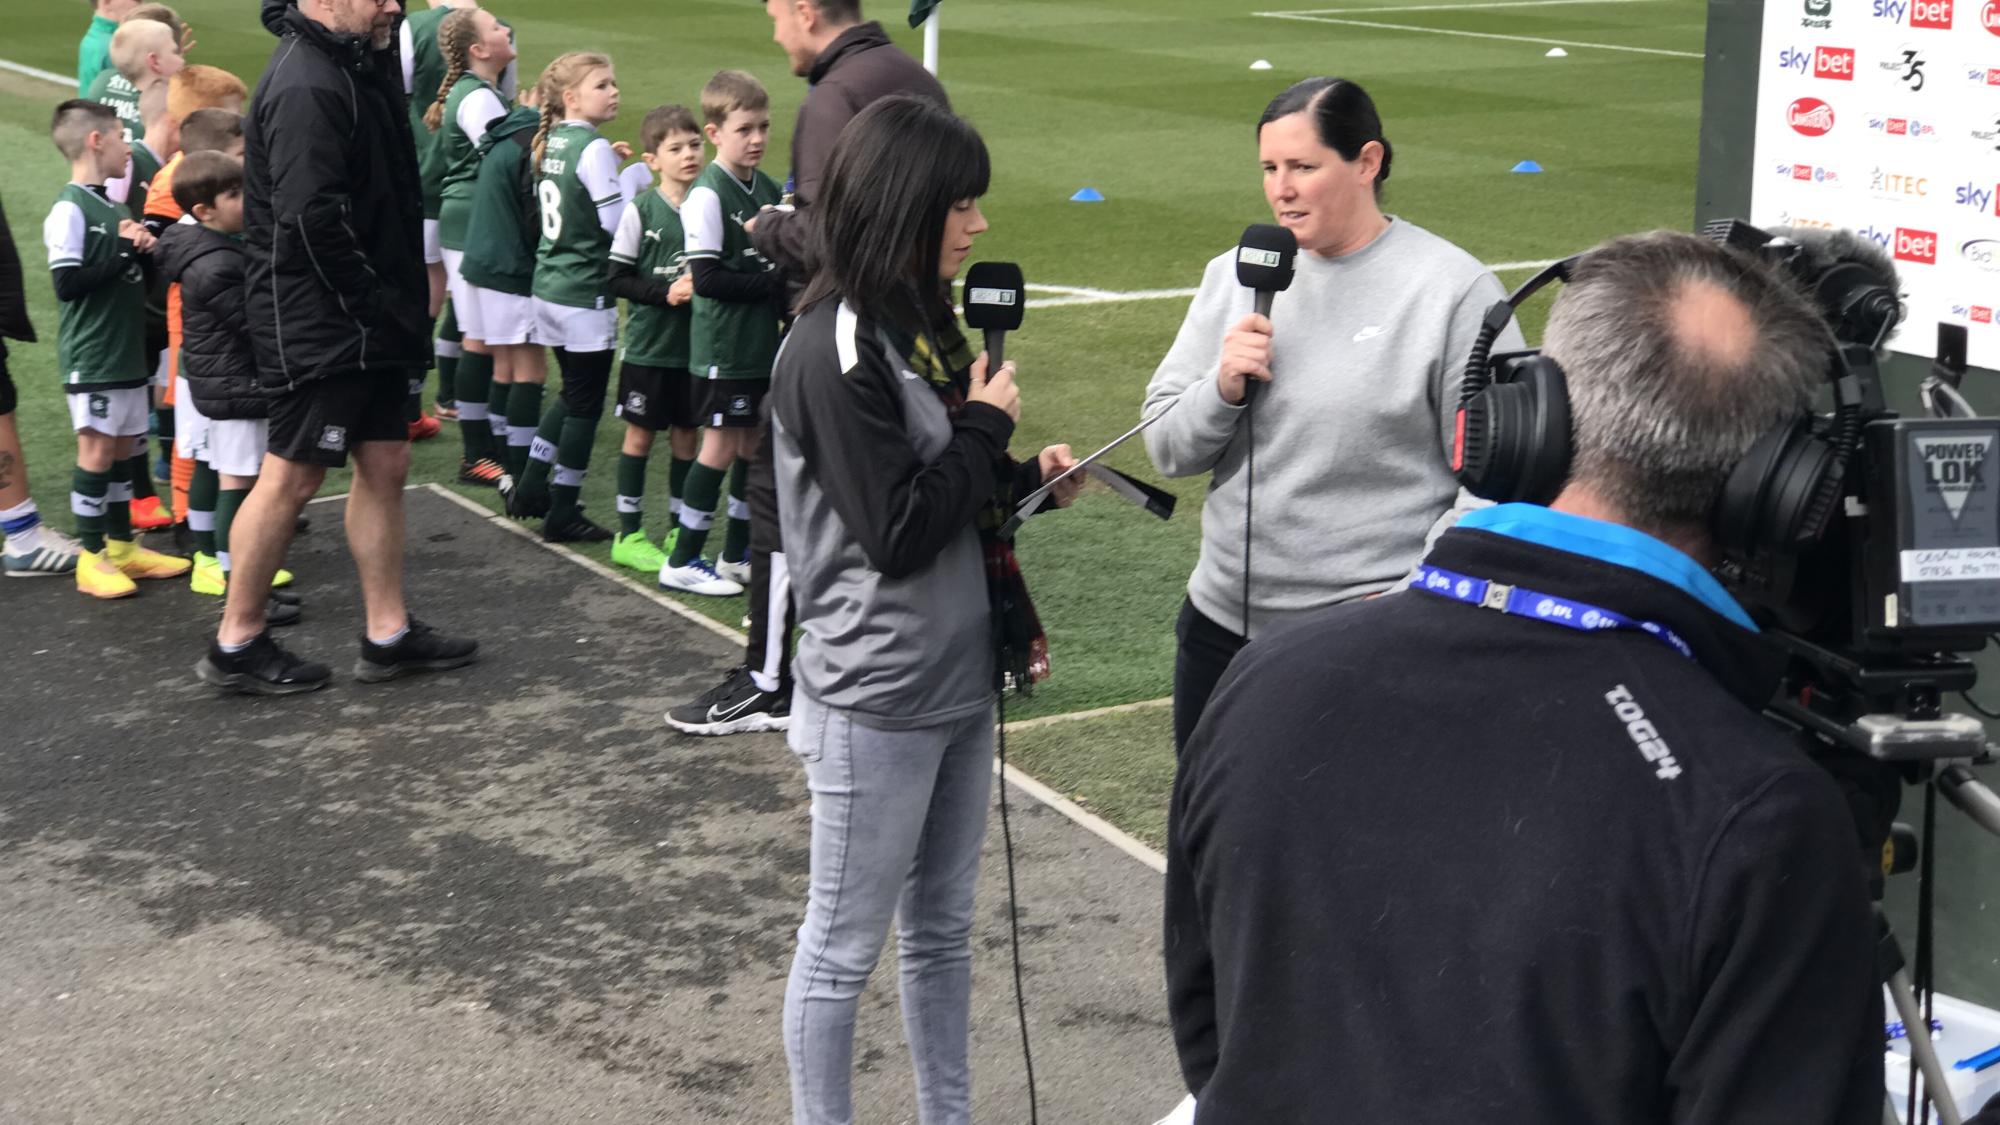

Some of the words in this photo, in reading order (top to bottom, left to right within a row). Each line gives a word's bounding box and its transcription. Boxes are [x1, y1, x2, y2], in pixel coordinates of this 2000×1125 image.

[1873, 0, 1907, 25] sky
[1913, 0, 1950, 22] bet
[1779, 46, 1811, 75] sky
[1817, 48, 1851, 74] bet
[1885, 174, 1928, 196] ITEC
[1955, 181, 1992, 213] sky
[538, 179, 563, 241] 8
[1897, 230, 1934, 257] bet
[1924, 443, 1985, 459] POWER
[1924, 460, 1985, 484] LOK
[1552, 604, 1573, 619] EFL
[1604, 684, 1683, 779] TOG24
